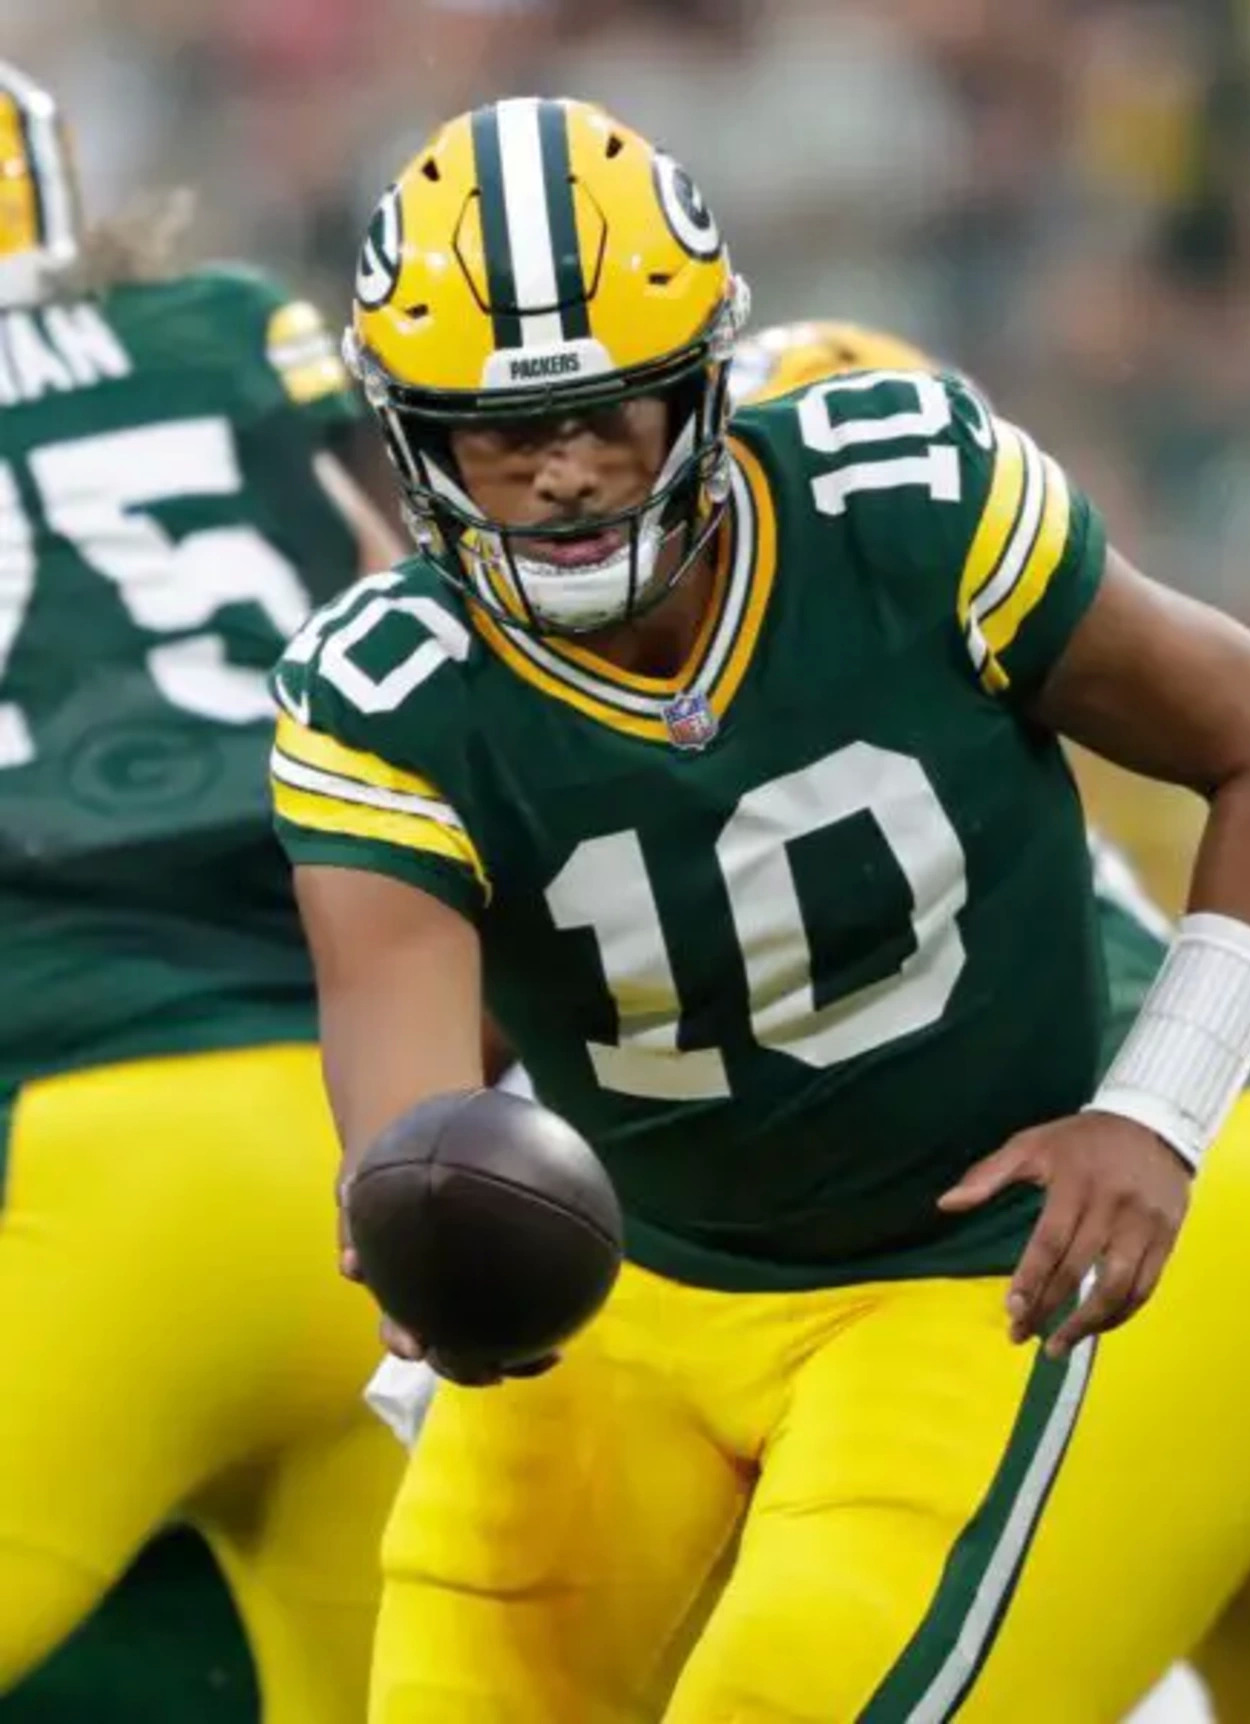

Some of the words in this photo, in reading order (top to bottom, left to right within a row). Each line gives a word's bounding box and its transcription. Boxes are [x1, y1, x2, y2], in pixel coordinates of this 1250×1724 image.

[0, 303, 133, 406] AN
[509, 352, 580, 380] PACKERS
[796, 368, 961, 516] 10
[544, 740, 968, 1100] 10
